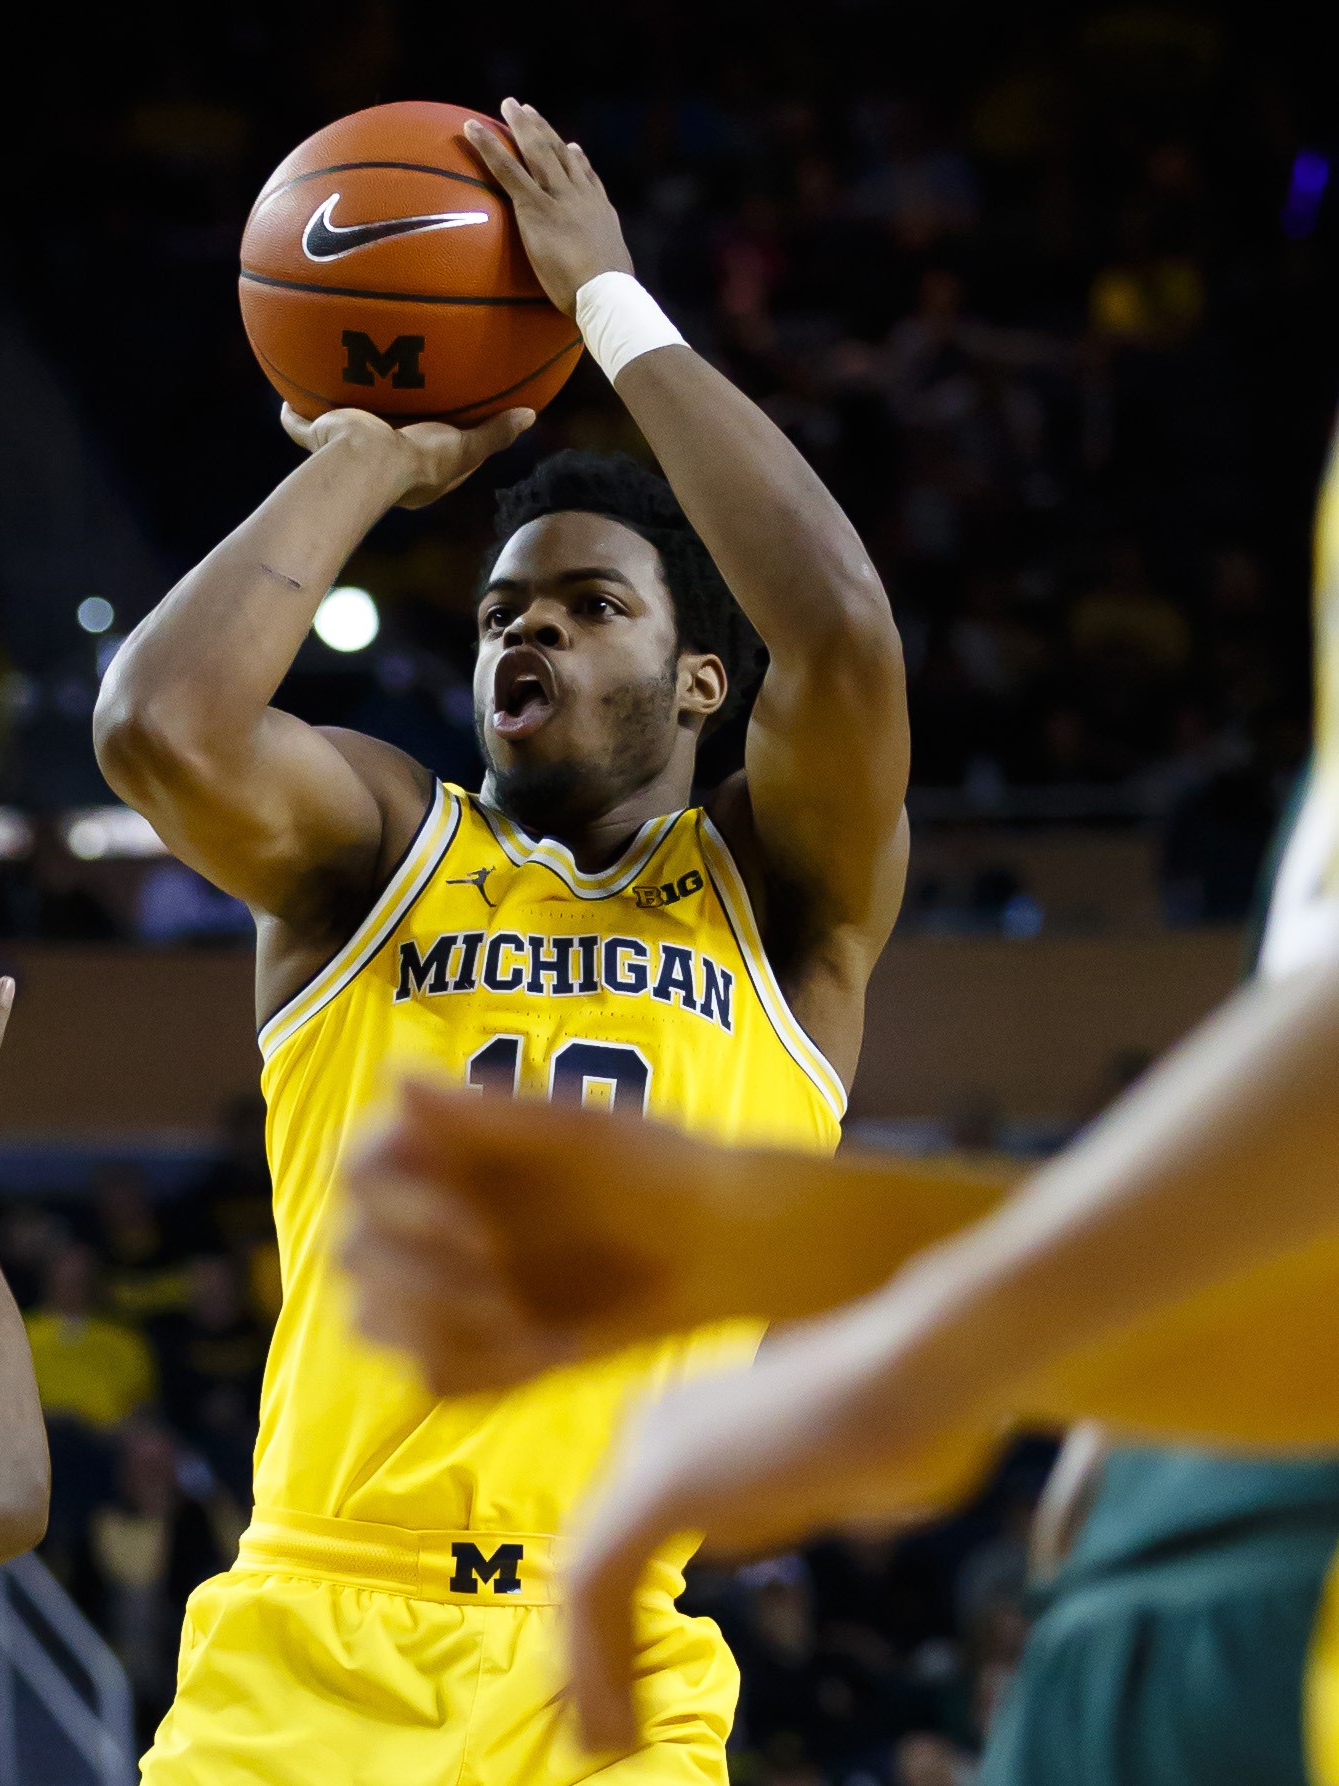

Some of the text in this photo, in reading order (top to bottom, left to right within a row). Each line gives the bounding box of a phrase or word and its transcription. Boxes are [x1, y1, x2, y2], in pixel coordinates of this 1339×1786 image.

[341, 329, 426, 390] M
[393, 930, 735, 1036] MICHIGAN
[450, 1542, 524, 1594] M
